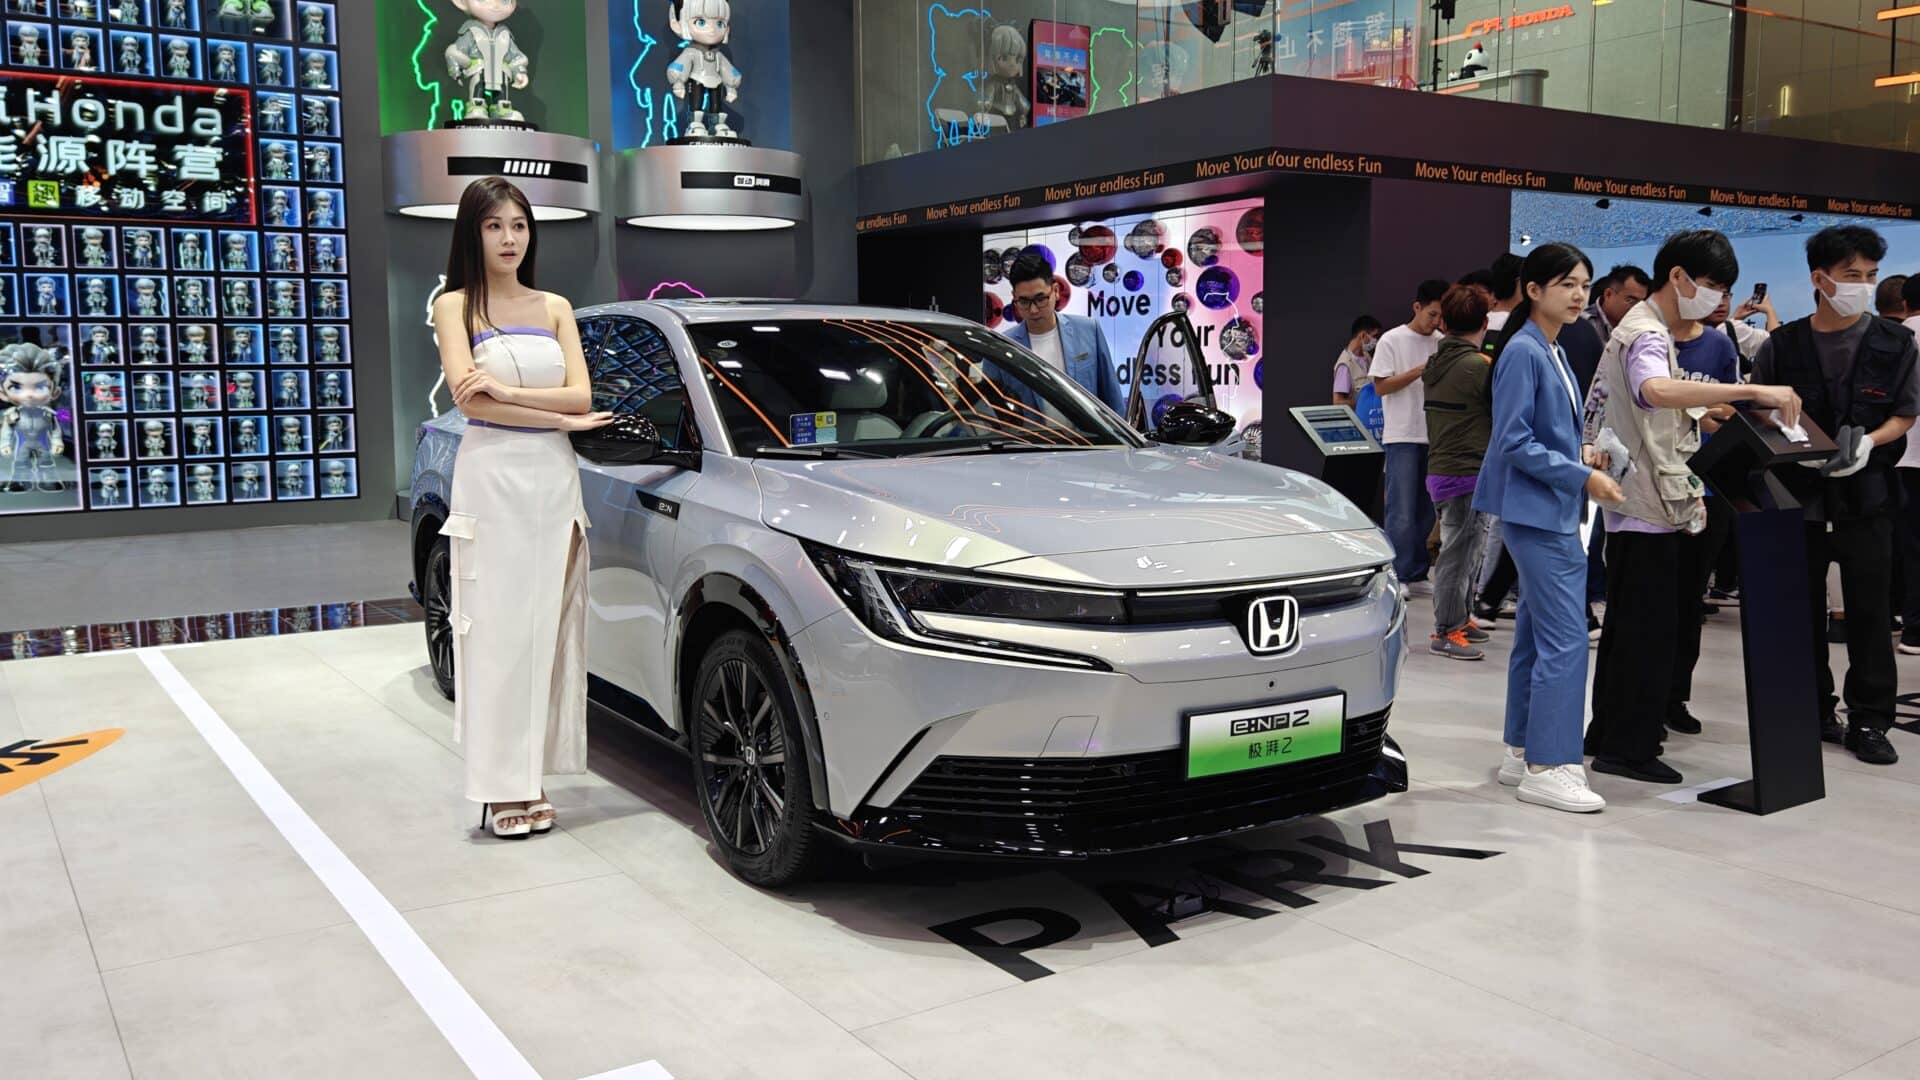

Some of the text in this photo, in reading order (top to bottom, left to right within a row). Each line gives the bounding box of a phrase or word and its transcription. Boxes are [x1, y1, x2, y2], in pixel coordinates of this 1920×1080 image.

[1196, 154, 1263, 178] Move Your
[1303, 153, 1354, 171] endless
[1358, 156, 1382, 174] Fun
[1415, 161, 1546, 188] Move Your endless Fun
[1044, 171, 1165, 201] Move Your endless Fun
[1574, 176, 1686, 200] Move Your endless Fun
[926, 194, 1021, 221] Move Your endless Fun
[1710, 188, 1808, 209] Move Your endless Fun
[1828, 199, 1849, 213] Move
[893, 212, 908, 225] Fun
[1088, 290, 1151, 317] Move
[927, 819, 1507, 983] PARK
